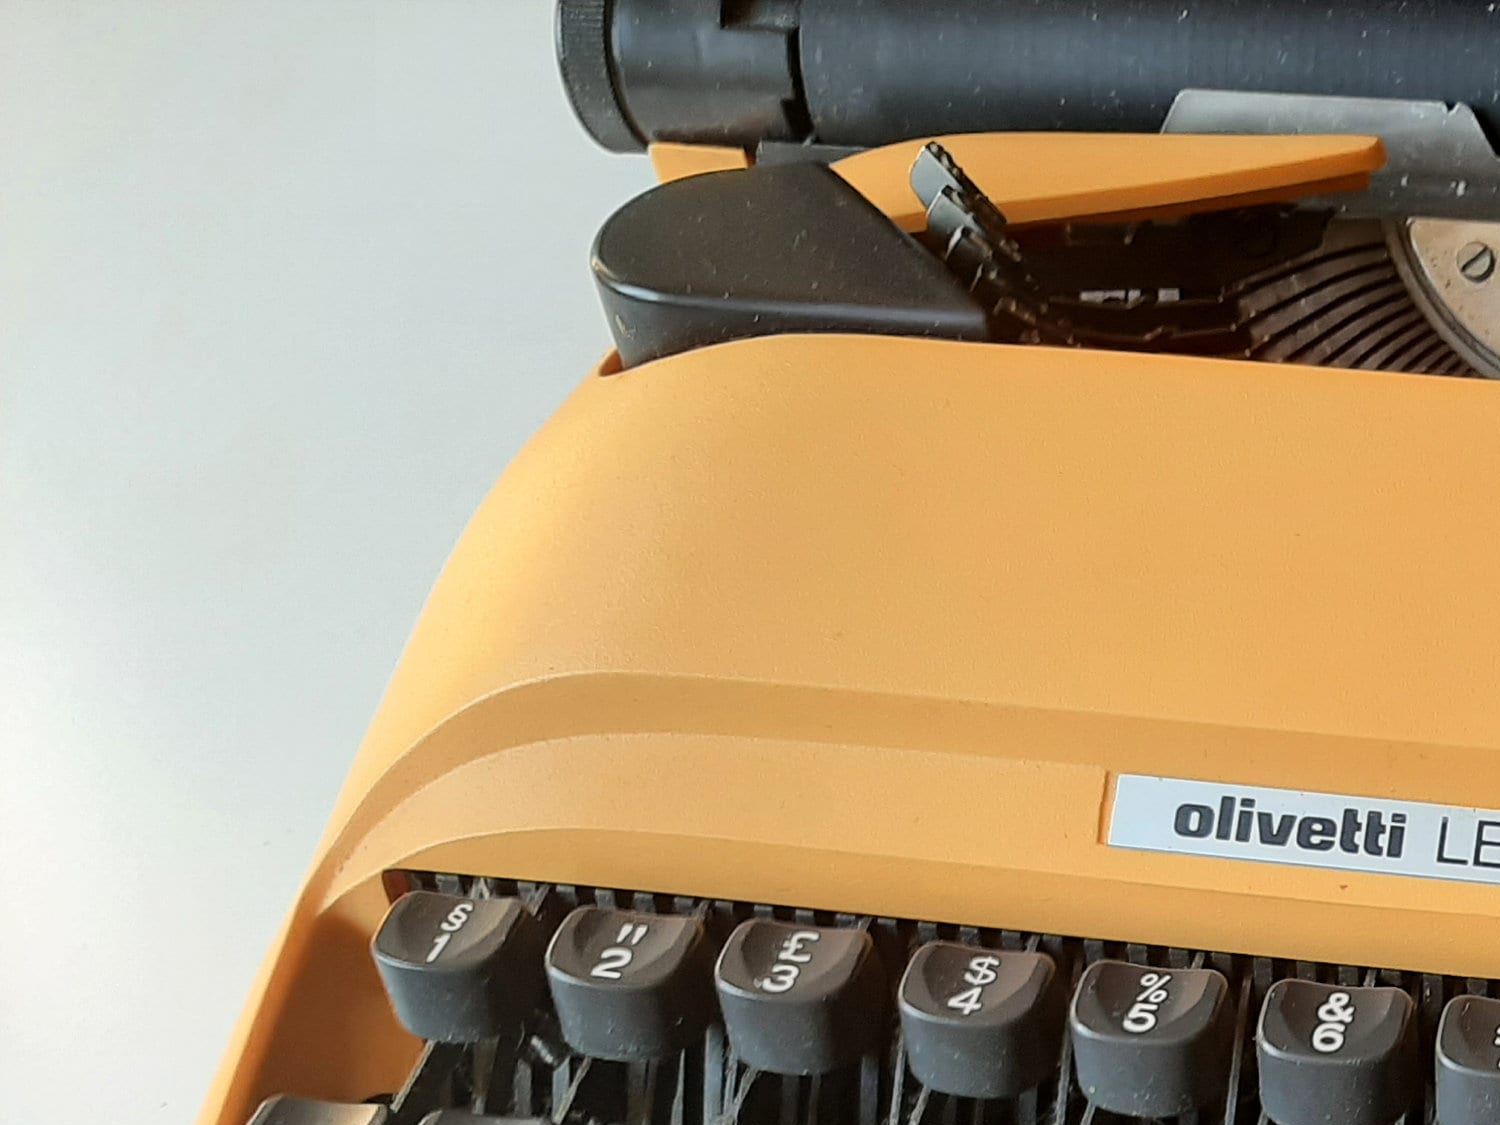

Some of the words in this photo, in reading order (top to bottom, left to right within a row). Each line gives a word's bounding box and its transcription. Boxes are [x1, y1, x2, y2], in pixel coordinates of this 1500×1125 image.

[1174, 795, 1407, 859] olivetti
[425, 932, 452, 963] 1
[590, 947, 633, 980] 2
[762, 964, 800, 993] 3
[946, 985, 984, 1016] 4
[1122, 1002, 1159, 1033] 5
[1311, 1022, 1347, 1053] 6
[440, 903, 474, 932] §
[778, 931, 820, 963] £
[963, 955, 1000, 988] $
[1137, 972, 1172, 1003] %
[1317, 991, 1356, 1025] &
